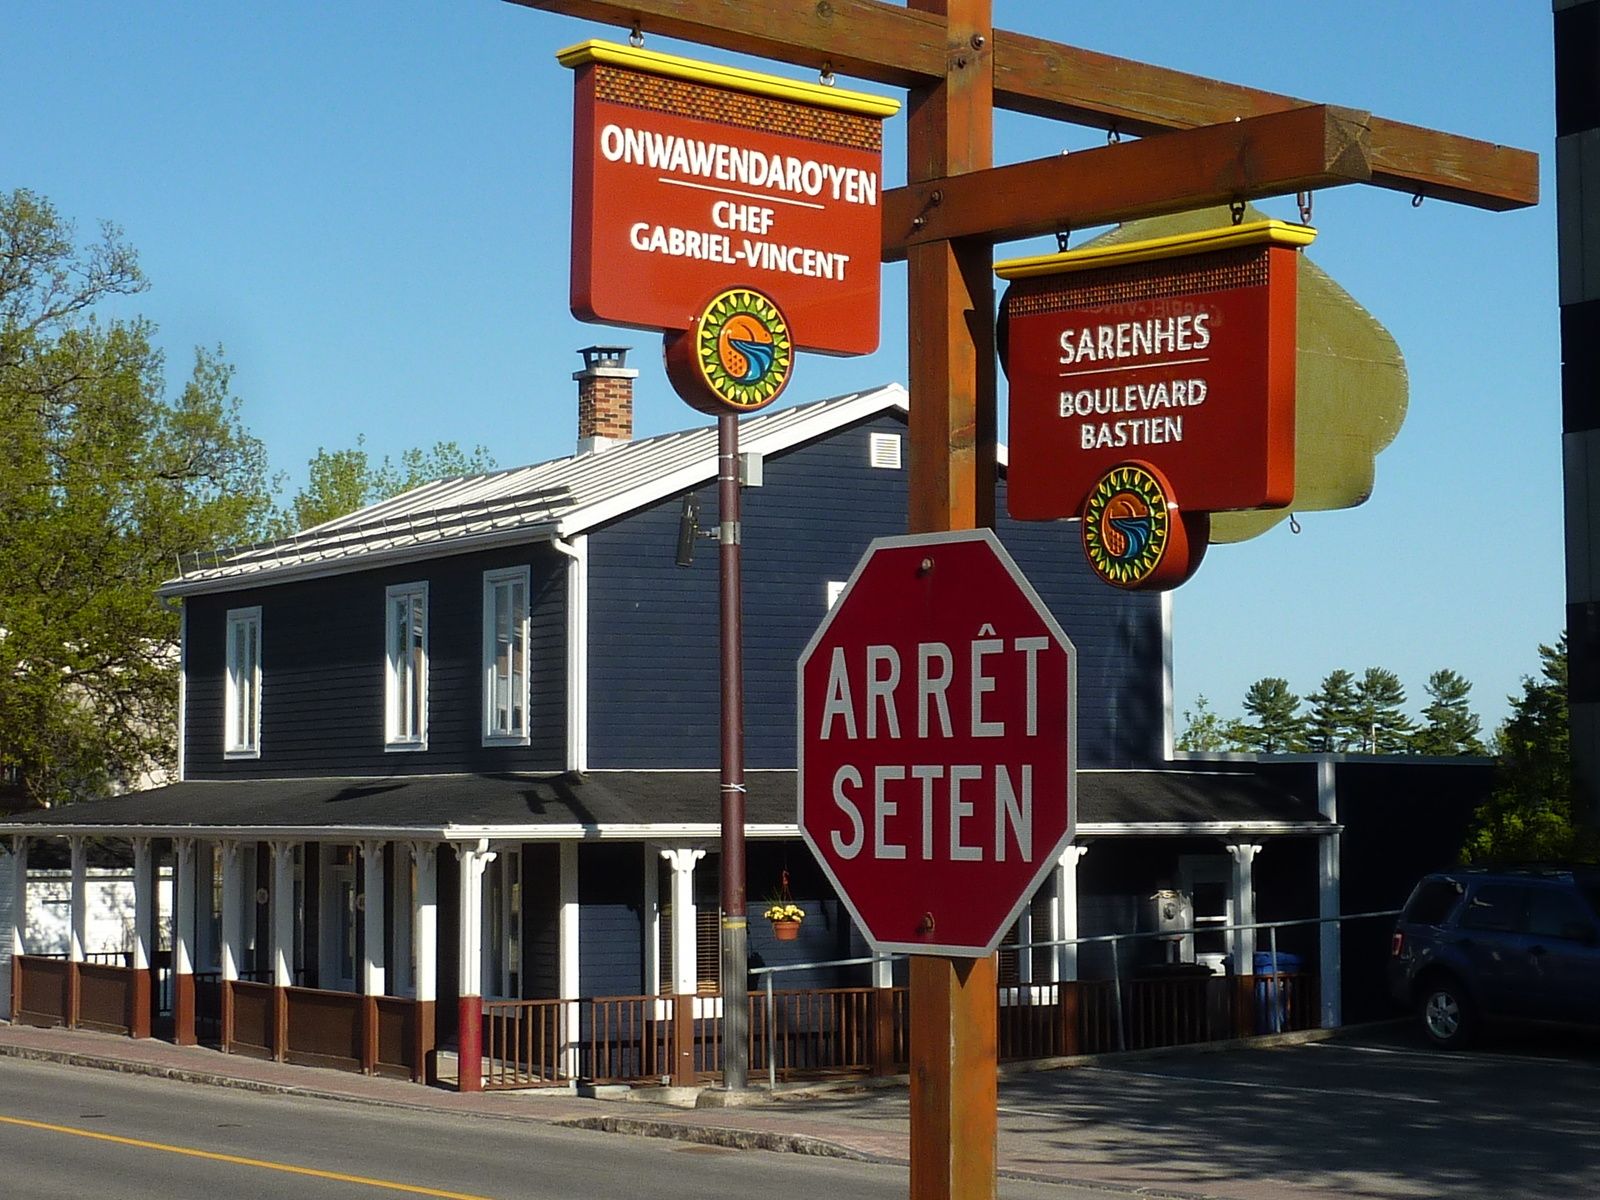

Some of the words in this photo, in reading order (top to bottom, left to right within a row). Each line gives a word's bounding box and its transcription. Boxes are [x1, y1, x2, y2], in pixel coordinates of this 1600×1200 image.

[600, 123, 878, 206] ONWAWENDARO'YEN
[710, 200, 775, 236] CHEF
[628, 221, 850, 281] GABRIEL-VINCENT
[1059, 313, 1210, 365] SARENHES
[1059, 379, 1208, 418] BOULEVARD
[1081, 415, 1183, 450] BASTIEN
[819, 622, 1050, 740] ARRÊT
[830, 764, 1032, 862] SETEN
